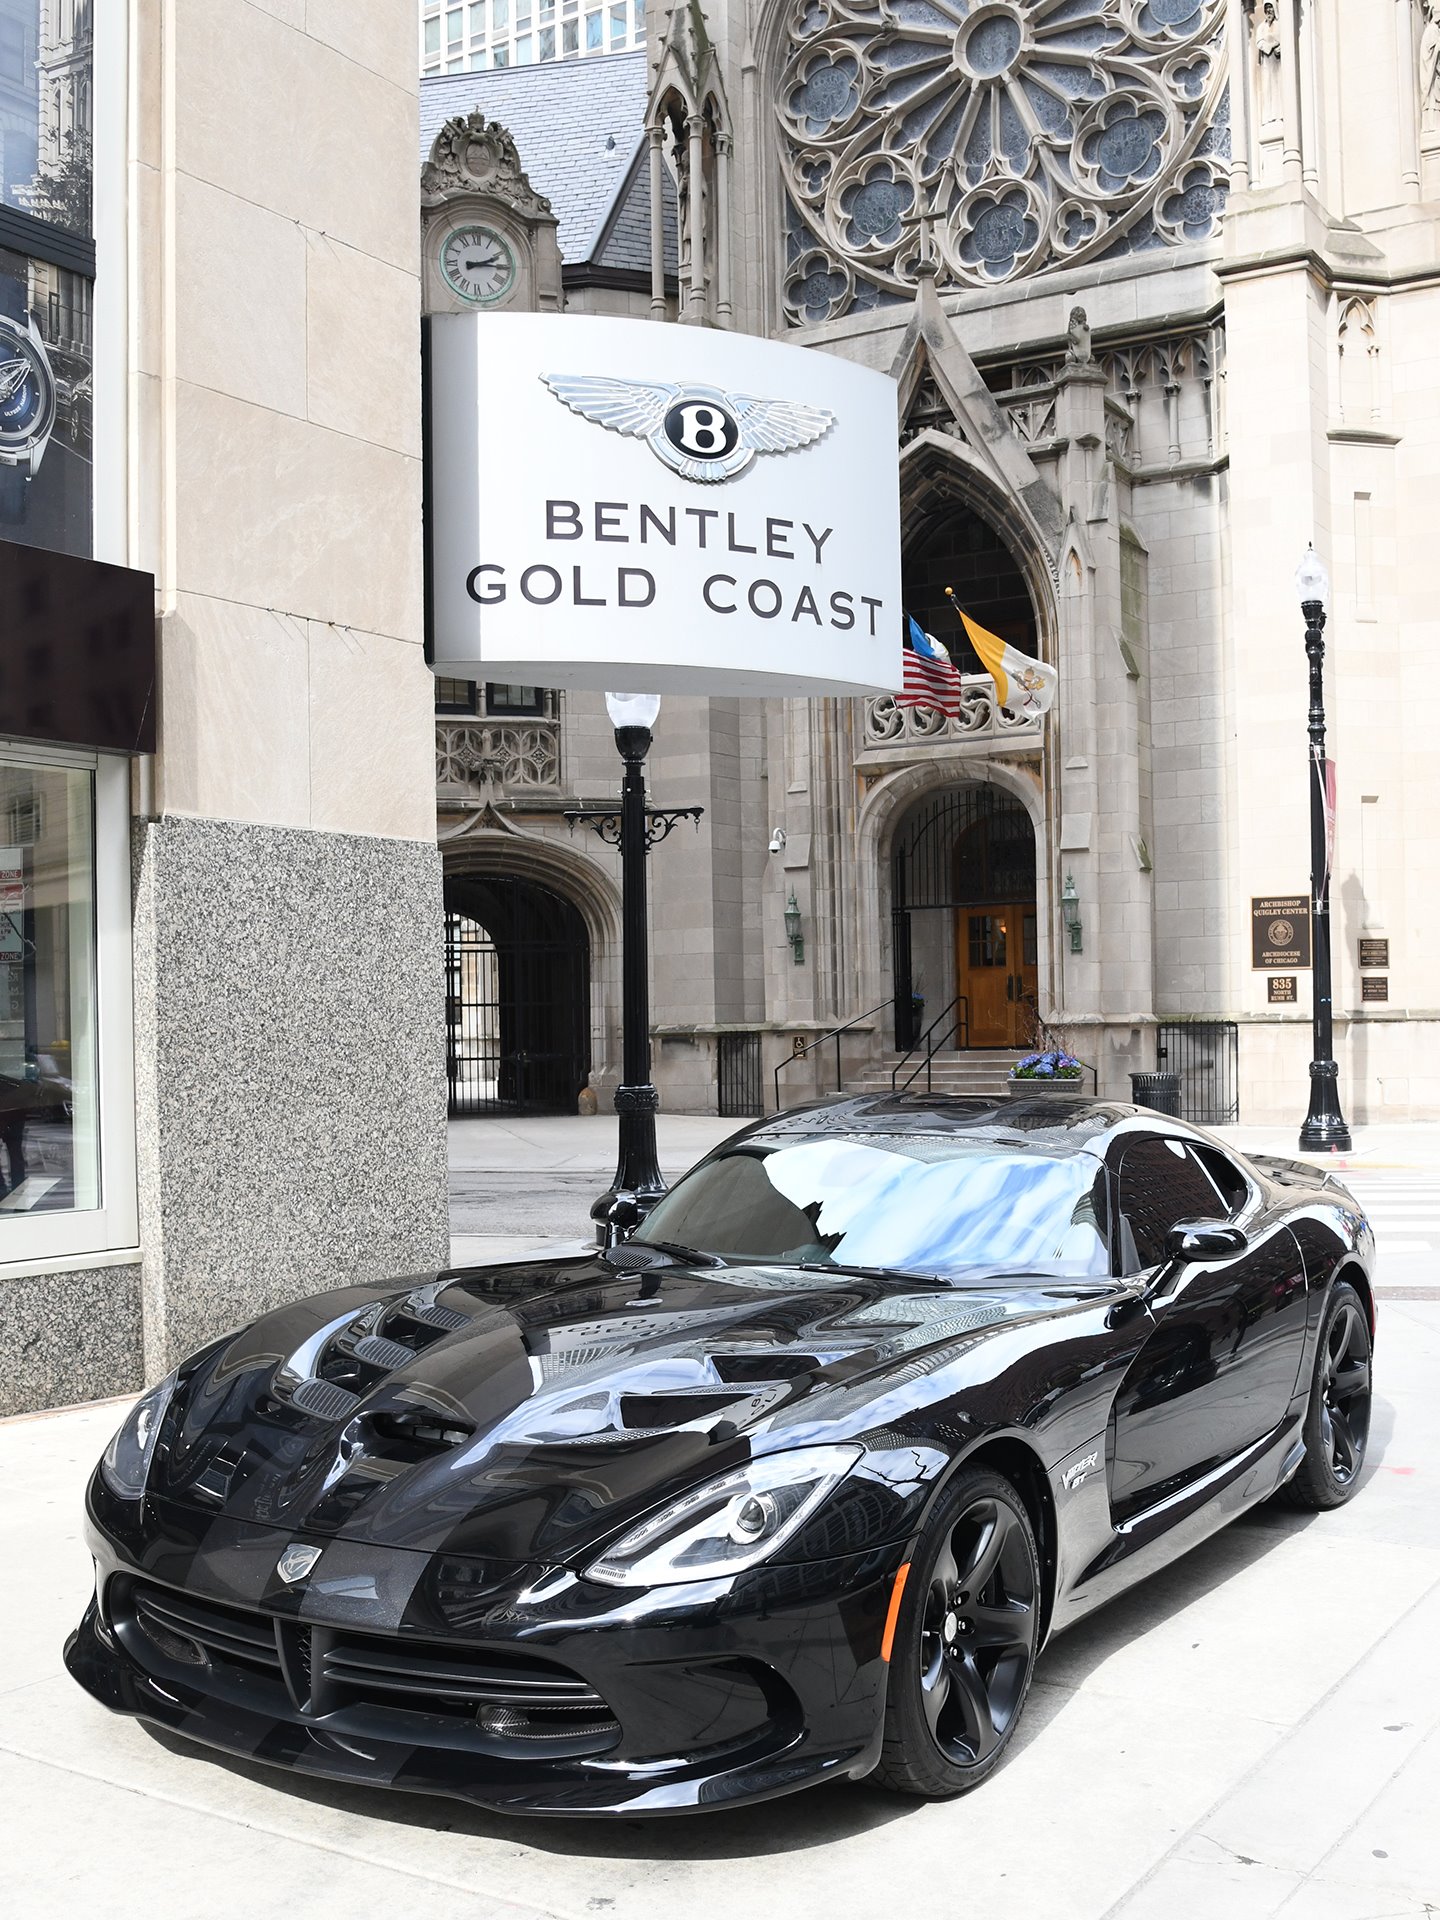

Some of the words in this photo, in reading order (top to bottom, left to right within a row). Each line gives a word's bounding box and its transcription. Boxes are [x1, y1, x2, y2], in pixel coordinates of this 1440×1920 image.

[680, 404, 727, 454] B
[545, 500, 833, 564] BENTLEY
[466, 564, 656, 607] GOLD
[703, 574, 883, 636] COAST
[1254, 909, 1281, 917] QUIGLEY
[1273, 978, 1292, 989] 835
